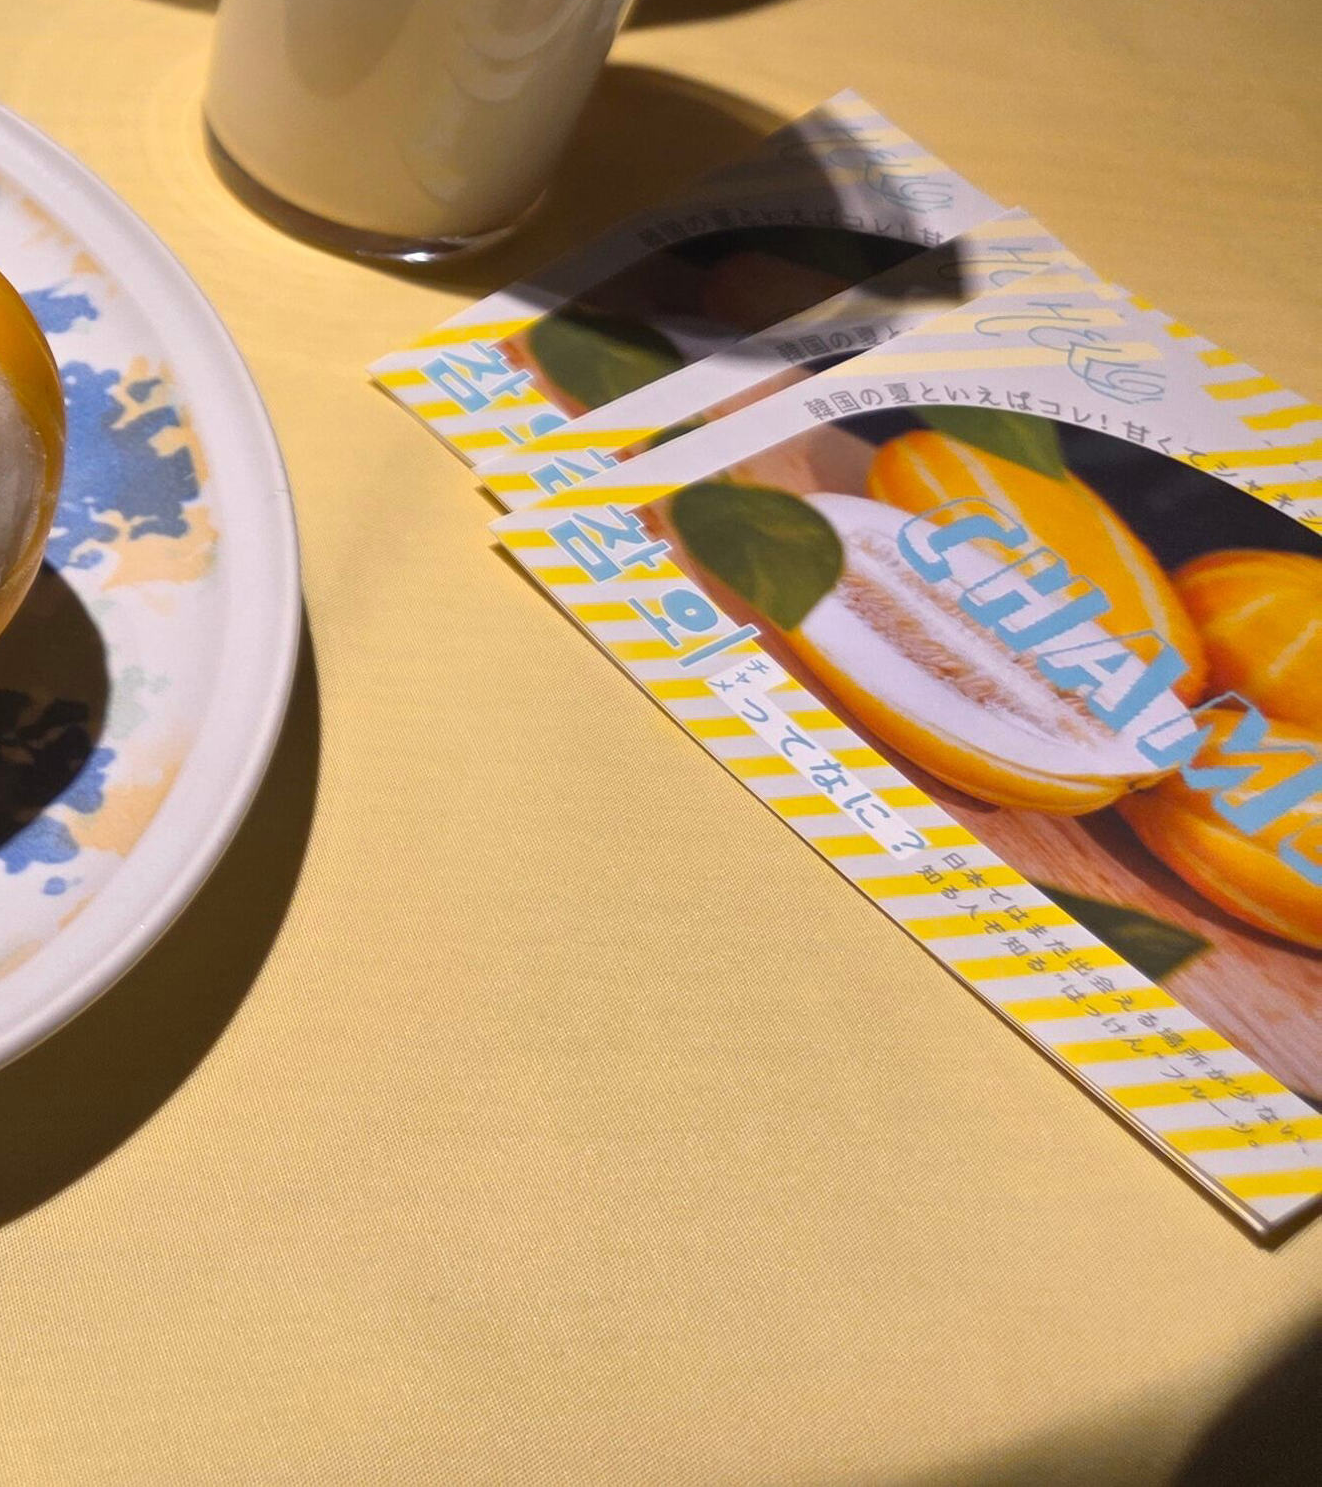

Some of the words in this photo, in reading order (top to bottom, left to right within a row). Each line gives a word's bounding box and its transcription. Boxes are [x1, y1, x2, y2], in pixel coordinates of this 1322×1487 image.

[547, 505, 760, 668] 참외
[709, 659, 769, 693] チャメ
